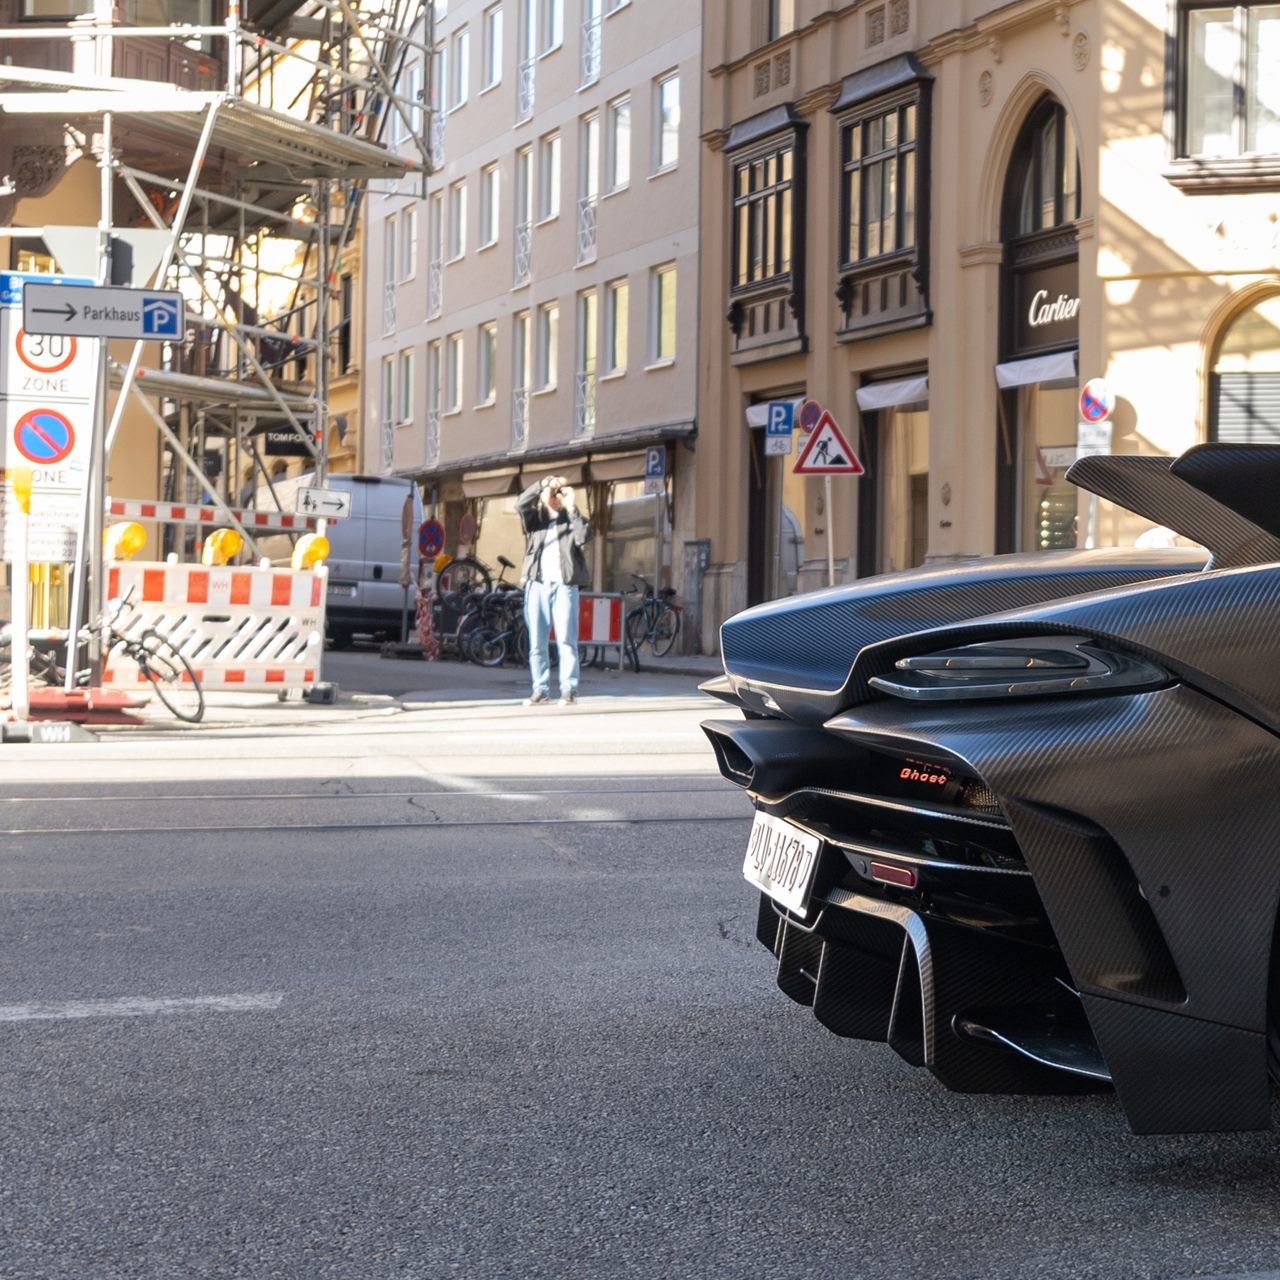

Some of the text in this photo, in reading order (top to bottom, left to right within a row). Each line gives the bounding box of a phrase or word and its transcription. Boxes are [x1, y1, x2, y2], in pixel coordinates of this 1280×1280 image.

[84, 305, 140, 322] Parkhaus
[1028, 289, 1080, 326] Cartier
[22, 376, 70, 393] ZONE
[771, 406, 786, 431] P
[267, 432, 314, 443] TOM FOD
[31, 468, 68, 484] ONE
[212, 580, 228, 590] WH
[302, 618, 317, 627] WH
[40, 725, 70, 742] WH
[900, 767, 947, 785] Ghost
